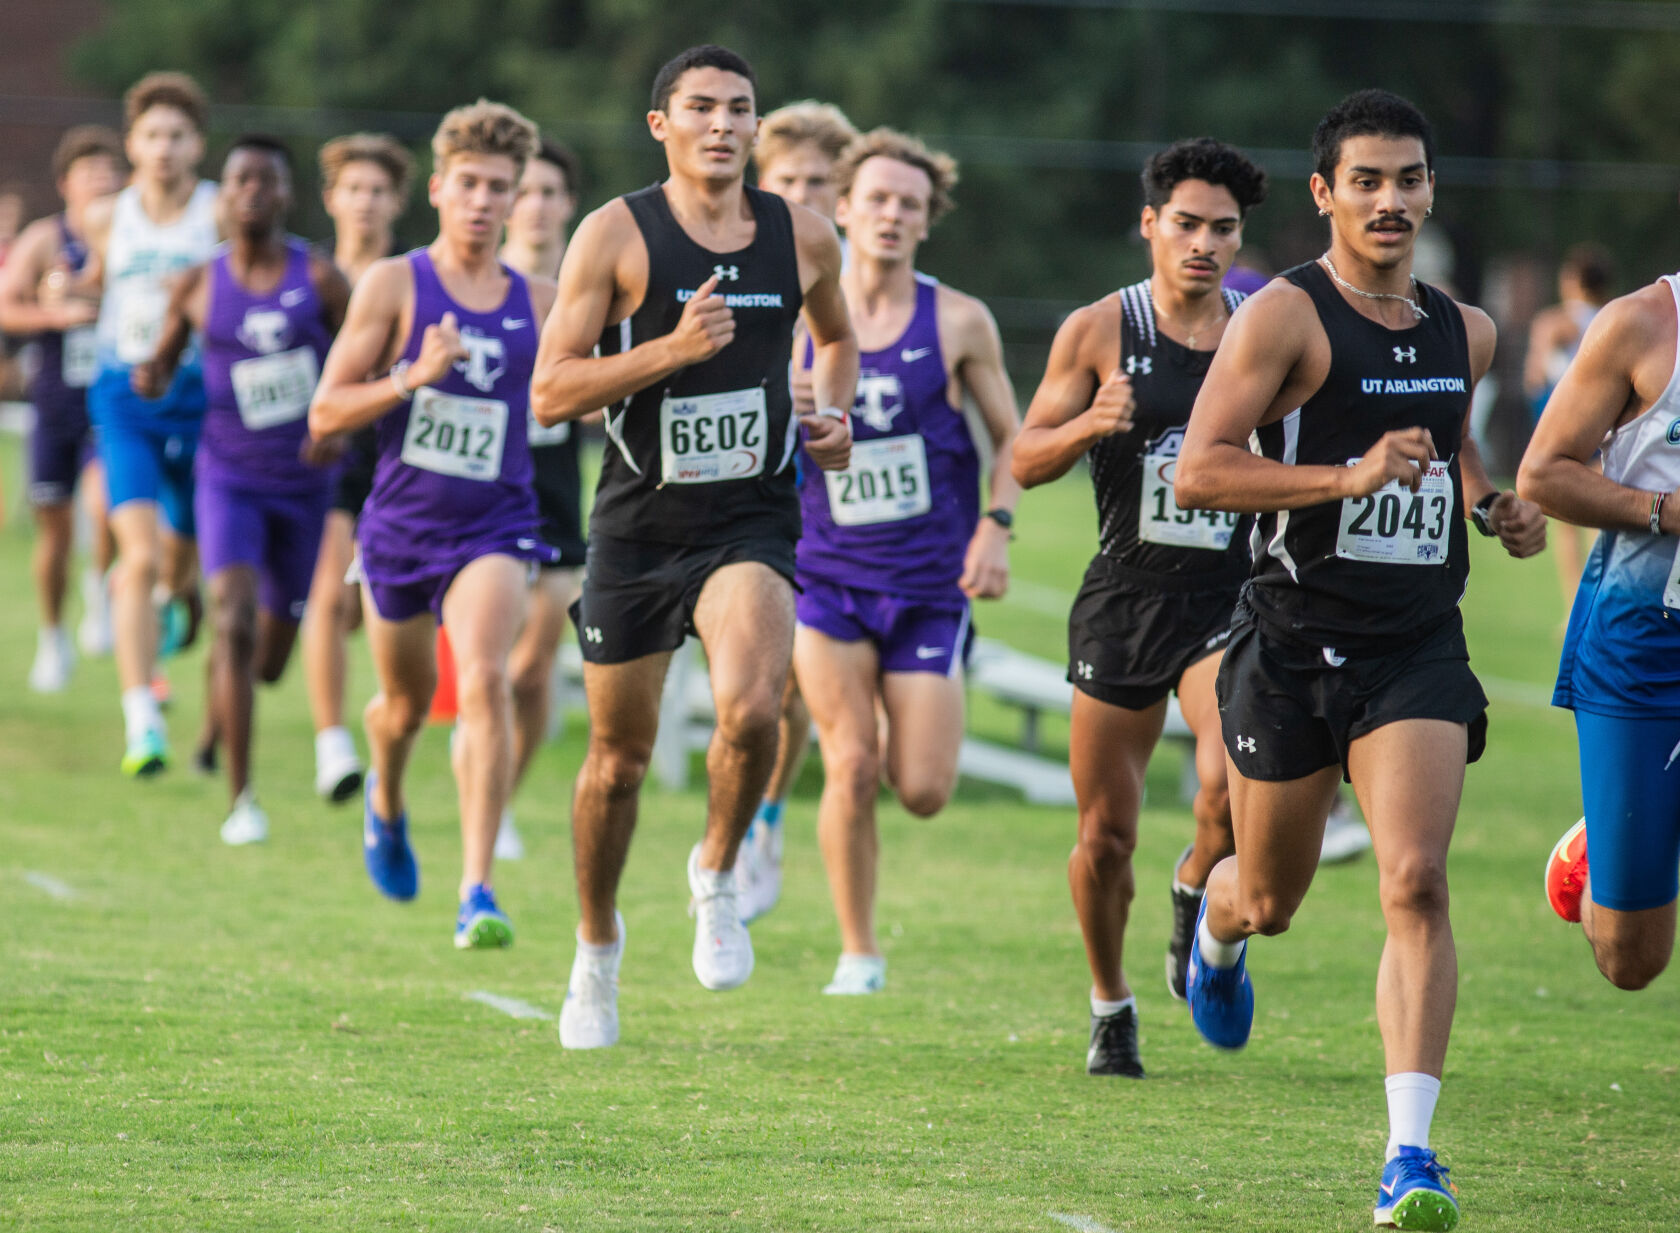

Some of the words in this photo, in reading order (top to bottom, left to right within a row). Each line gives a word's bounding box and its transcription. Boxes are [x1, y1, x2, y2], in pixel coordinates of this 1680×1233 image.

[1361, 379, 1382, 393] UT
[1384, 378, 1464, 394] ARLINGTON
[415, 416, 494, 460] 2012
[670, 411, 760, 455] 2039
[836, 464, 918, 504] 2015
[1347, 494, 1447, 540] 2043
